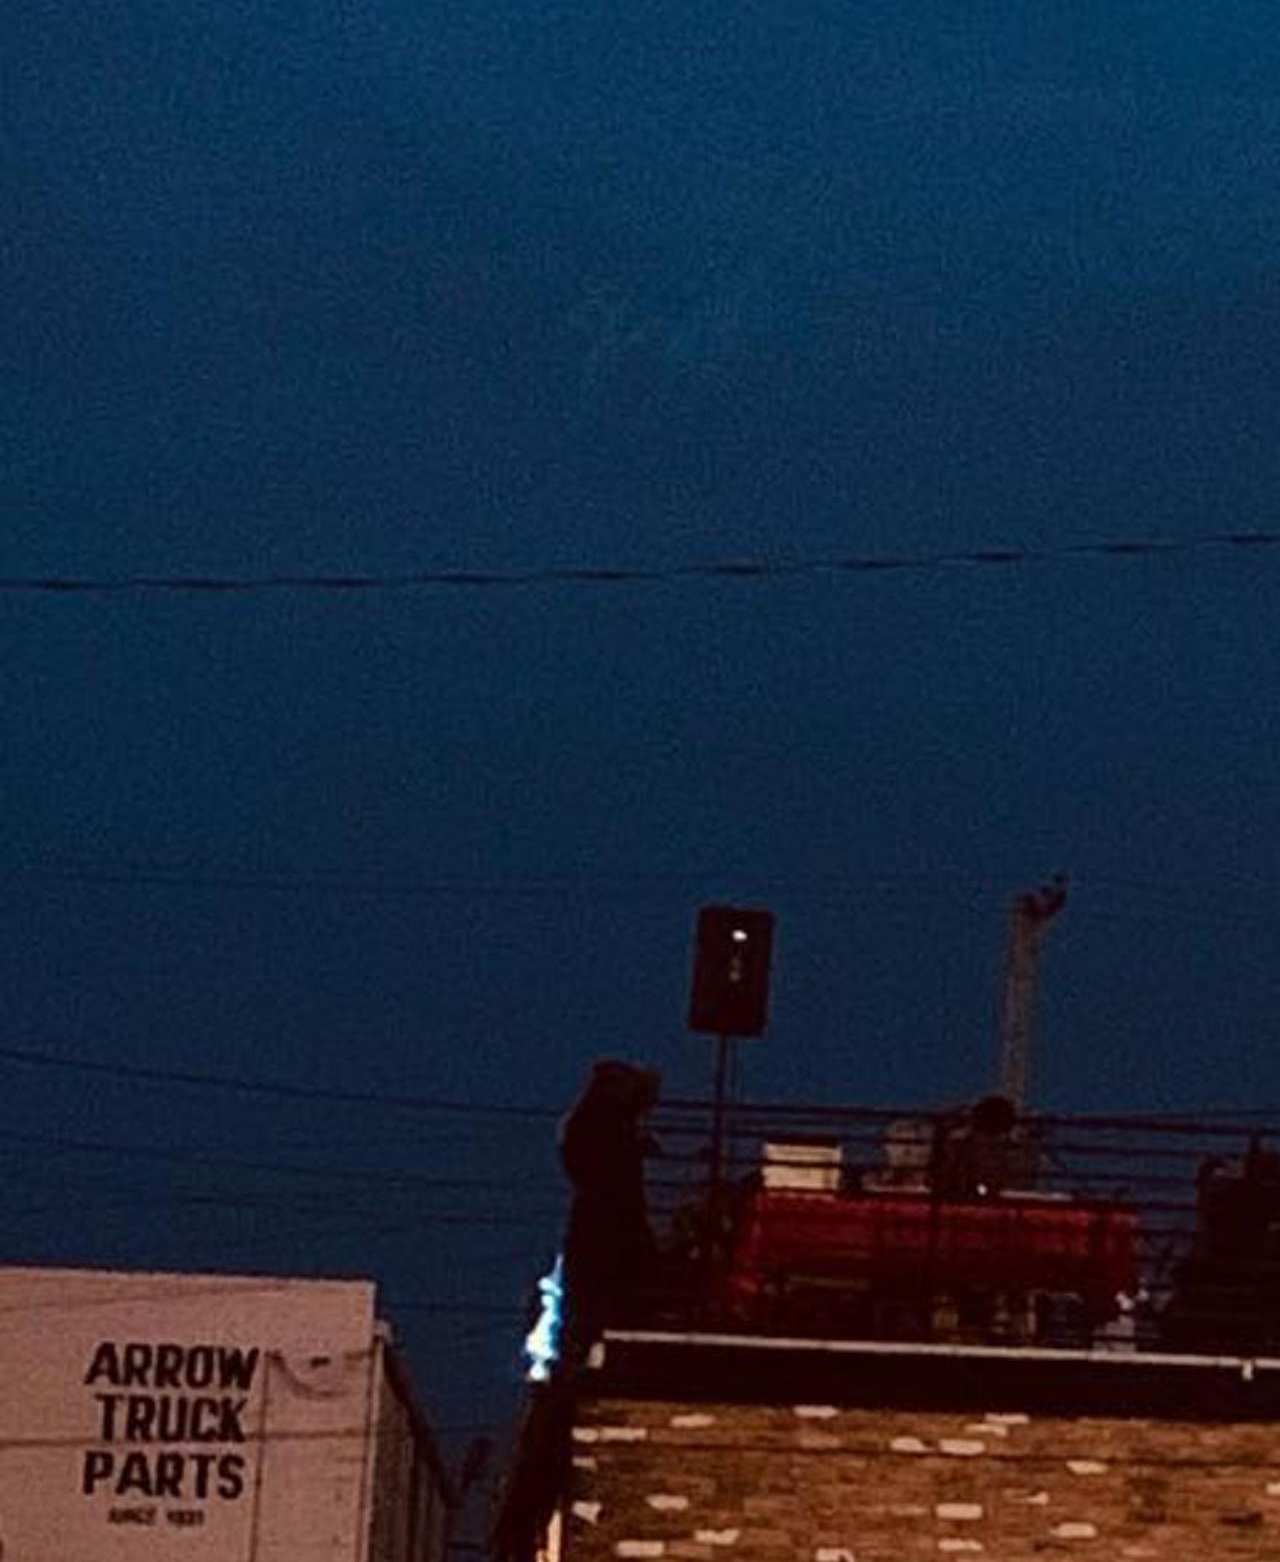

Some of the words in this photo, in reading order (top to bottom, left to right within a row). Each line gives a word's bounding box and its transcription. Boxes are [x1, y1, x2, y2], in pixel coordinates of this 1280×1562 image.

[84, 1343, 259, 1389] ARROW
[95, 1394, 248, 1443] TRUCK
[83, 1450, 245, 1499] PARTS
